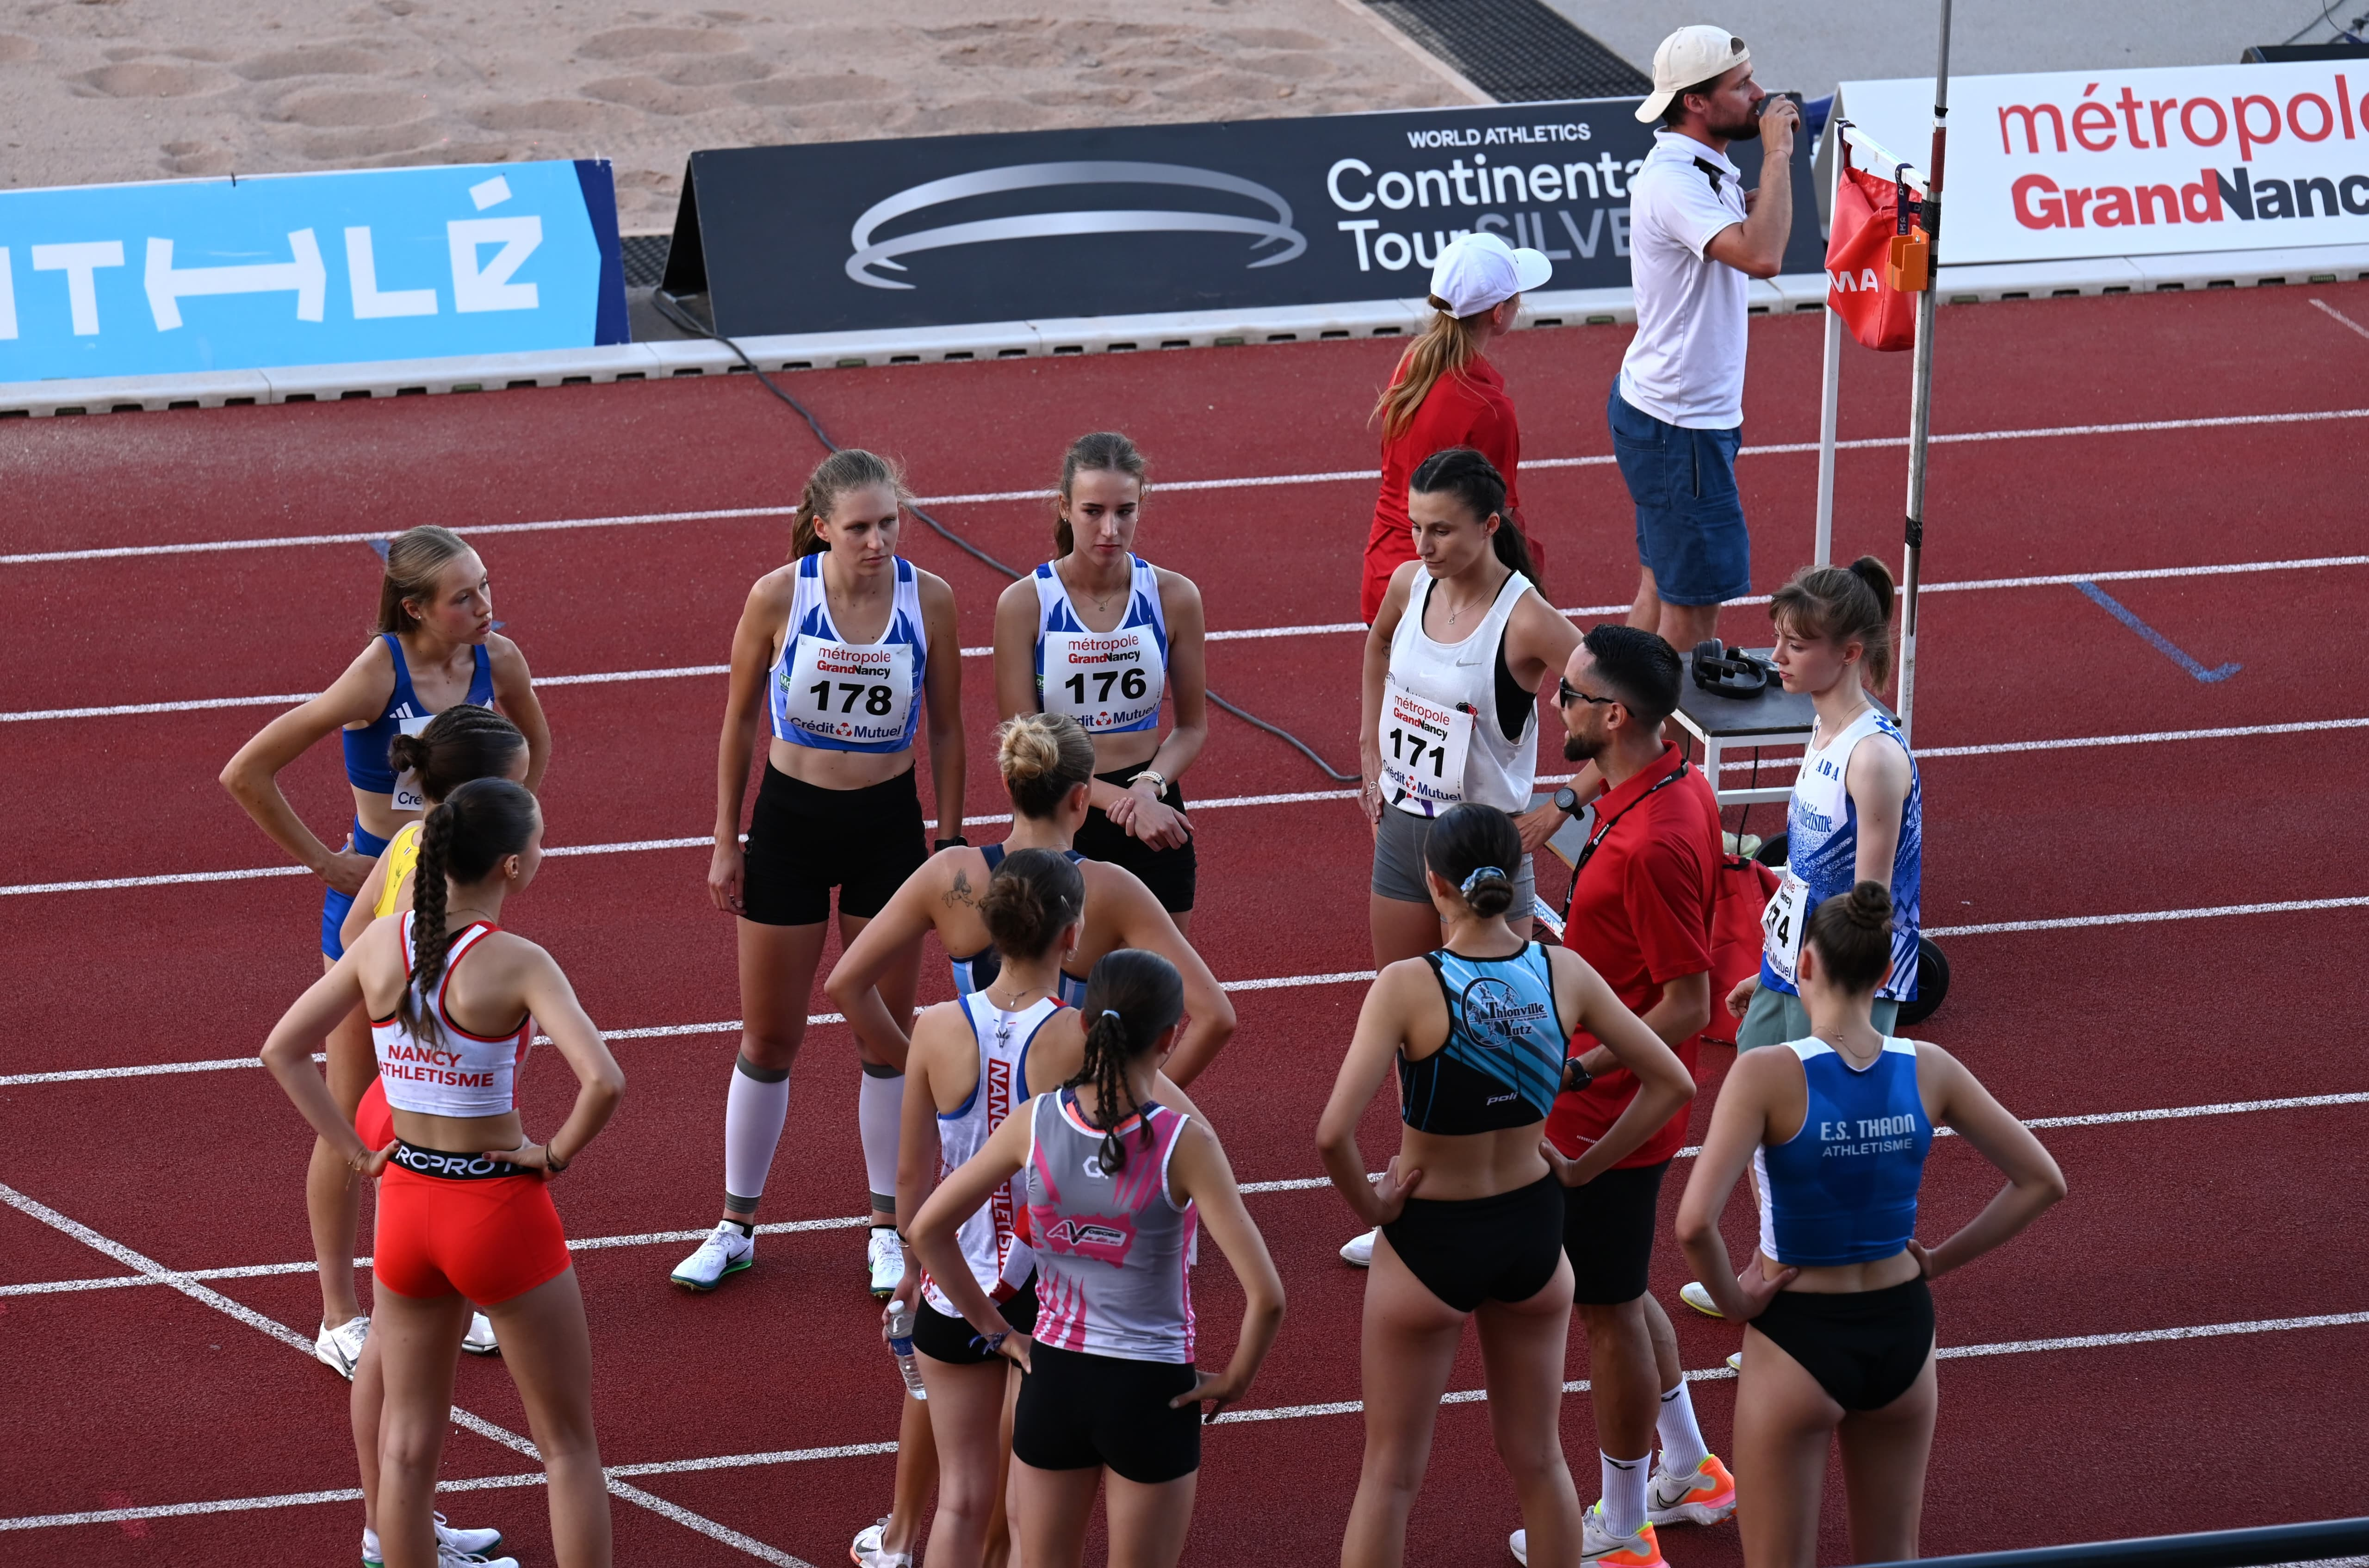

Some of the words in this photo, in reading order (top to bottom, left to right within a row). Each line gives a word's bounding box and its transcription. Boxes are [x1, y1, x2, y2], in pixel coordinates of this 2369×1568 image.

[1998, 74, 2369, 162] métropol
[1407, 129, 1480, 149] WORLD
[1485, 124, 1591, 145] ATHLETICS
[1338, 219, 1470, 272] Tou
[1068, 634, 1139, 651] métropole
[819, 647, 891, 665] métropole
[1068, 651, 1140, 663] GrandNancy
[817, 660, 890, 679] GrandNancy
[810, 680, 893, 715] 178
[1065, 668, 1147, 704] 176
[1114, 703, 1156, 724] Mutuel
[1395, 695, 1450, 725] métropole
[790, 718, 835, 734] Crédit
[854, 725, 902, 738] Mutuel
[1394, 707, 1448, 741] GrandNancy
[1389, 728, 1445, 778] 171
[1383, 759, 1405, 785] Crédit
[1417, 781, 1462, 800] Mutuel
[1772, 952, 1792, 978] Mutuel
[1486, 1002, 1545, 1018] Thionville
[1502, 1019, 1532, 1036] Yutz
[388, 1045, 462, 1067] NANCY
[379, 1061, 494, 1088] ATHLETISME
[1486, 1092, 1519, 1106] poli
[1820, 1122, 1851, 1141] E.S.
[1857, 1113, 1916, 1138] THAON
[1822, 1138, 1912, 1157] ATHLETISME
